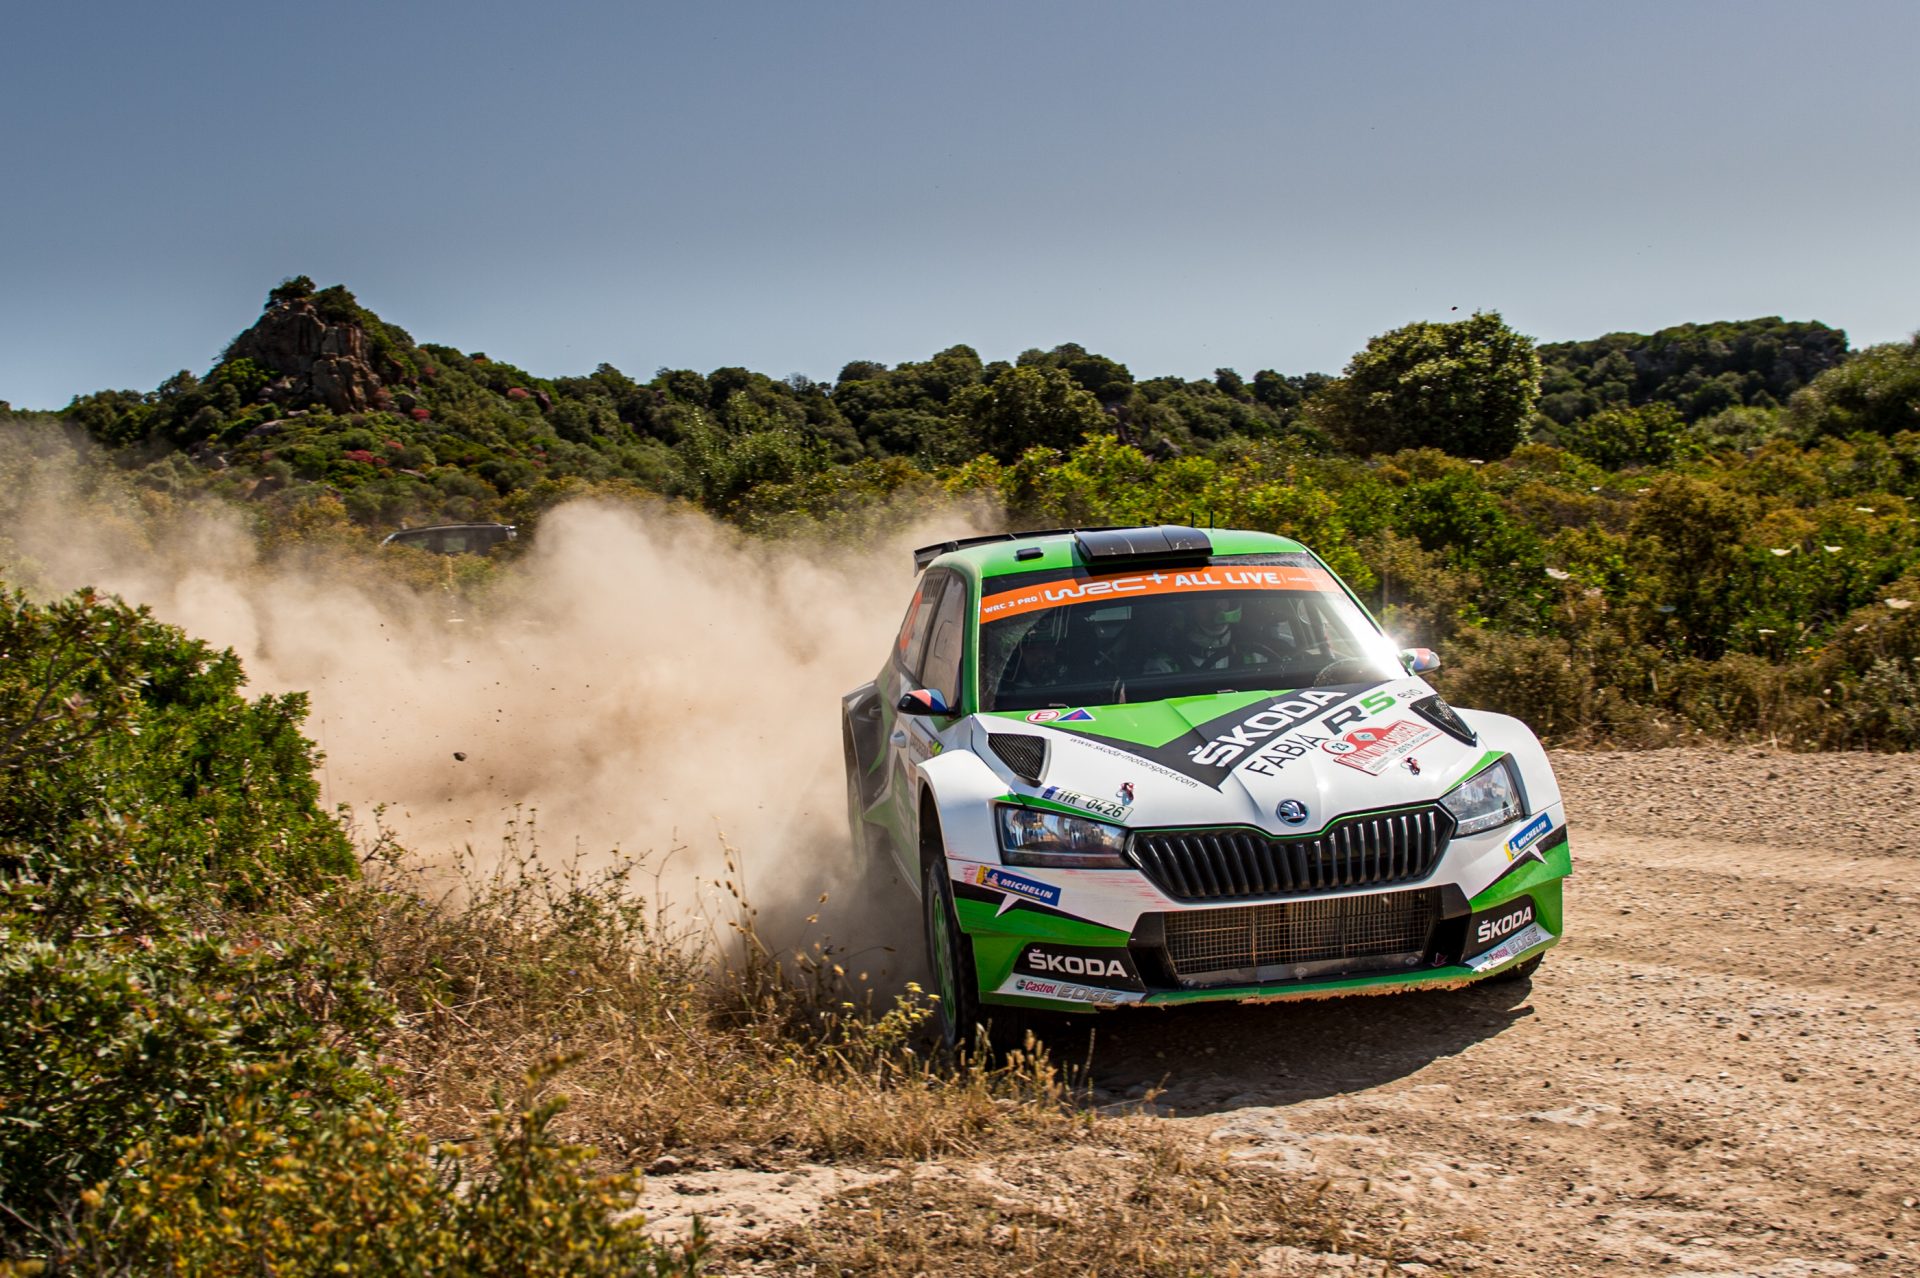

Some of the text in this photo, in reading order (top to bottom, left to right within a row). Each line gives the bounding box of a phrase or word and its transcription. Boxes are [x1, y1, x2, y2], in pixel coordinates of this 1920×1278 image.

[1175, 573, 1221, 587] ALL
[1225, 571, 1281, 585] LIVE
[983, 595, 1038, 614] WRC 2 PRO
[1187, 690, 1347, 767] ŠKODA
[1245, 733, 1330, 777] FABIA
[1322, 690, 1397, 736] R5
[1331, 742, 1350, 752] 23
[1069, 738, 1199, 789] www.skoda-motorsport.com
[1085, 798, 1126, 818] 0426
[1517, 819, 1547, 848] MICHELIN
[1000, 877, 1054, 899] MICHELIN
[1478, 905, 1532, 943] ŠKODA
[1508, 926, 1541, 954] EDGE
[1027, 948, 1129, 978] ŠKODA
[1024, 981, 1123, 1003] Castrol EDGE
